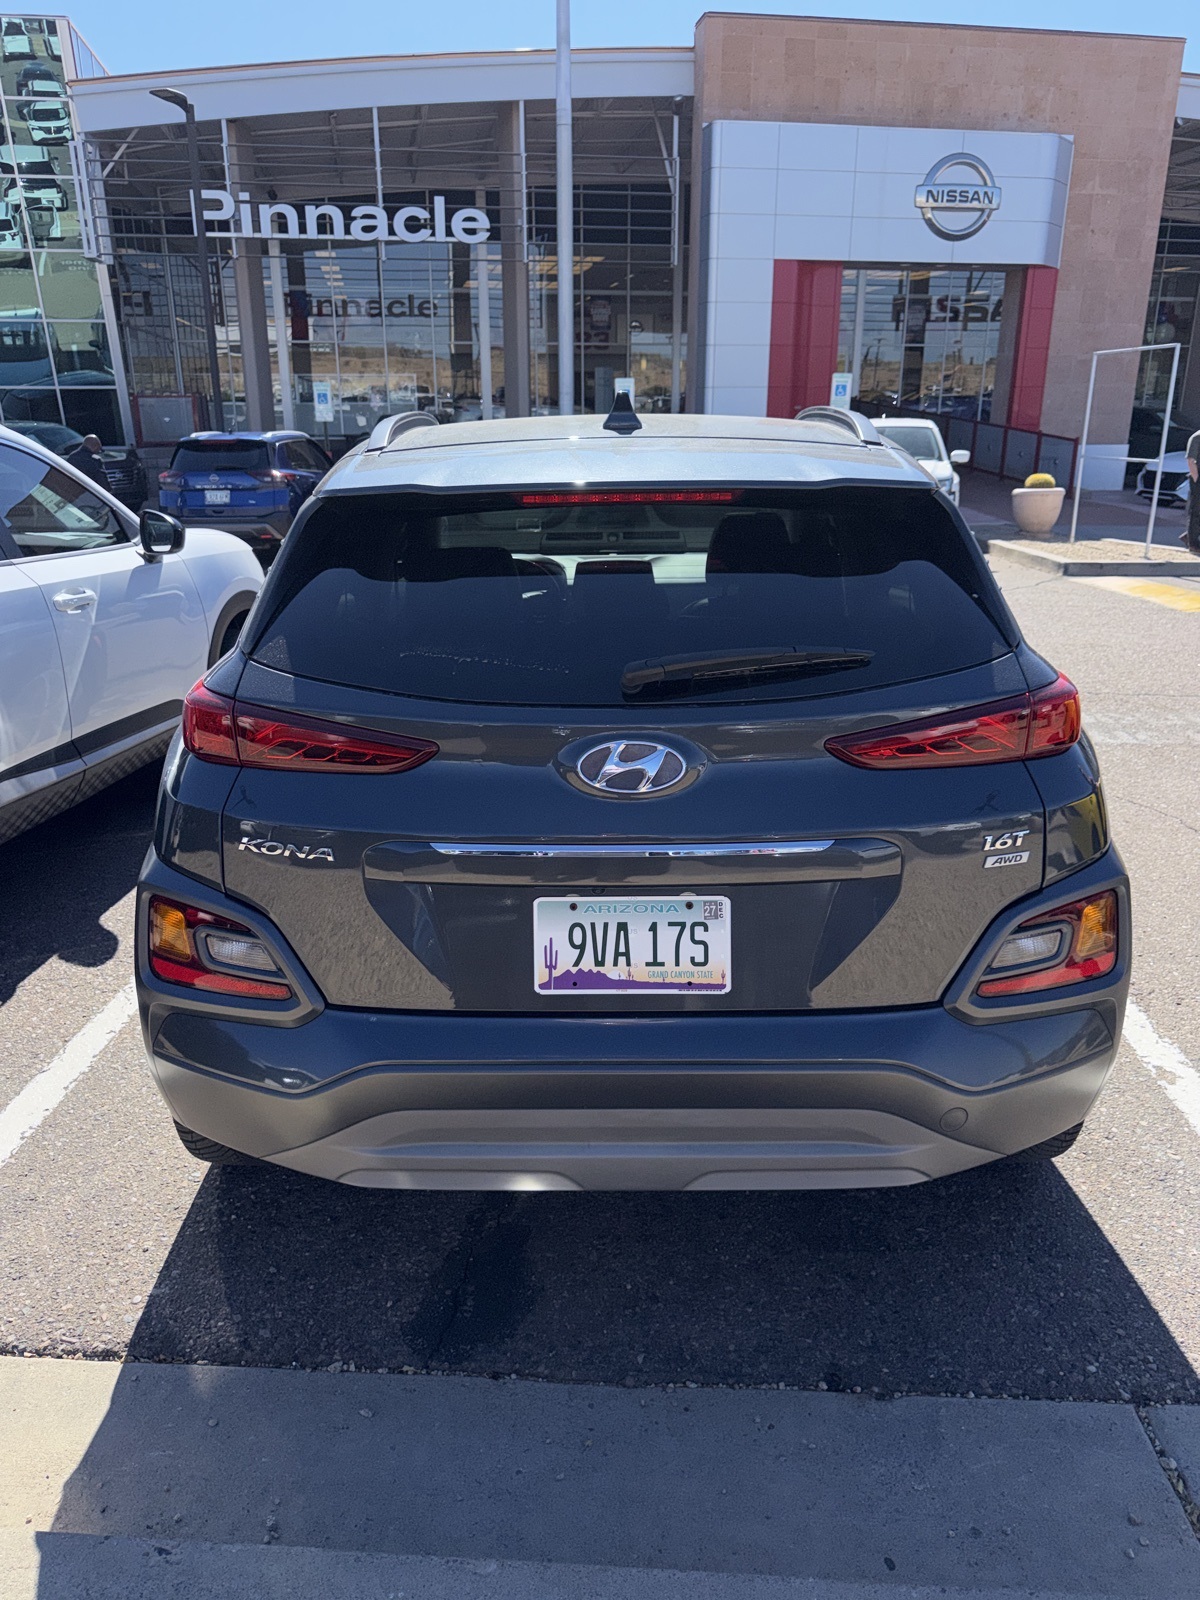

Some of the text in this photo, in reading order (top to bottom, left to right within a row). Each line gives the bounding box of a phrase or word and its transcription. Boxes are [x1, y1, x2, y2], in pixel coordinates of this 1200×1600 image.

[925, 189, 995, 205] NISSAN
[189, 188, 491, 244] Pinnacle
[983, 829, 1030, 851] 1.6T
[238, 836, 335, 862] KONA
[991, 854, 1023, 866] AWD
[582, 903, 681, 914] ARIZONA
[703, 905, 716, 917] 27
[567, 921, 710, 968] 9VA 17S
[647, 970, 714, 979] GRAND CANYON STATE
